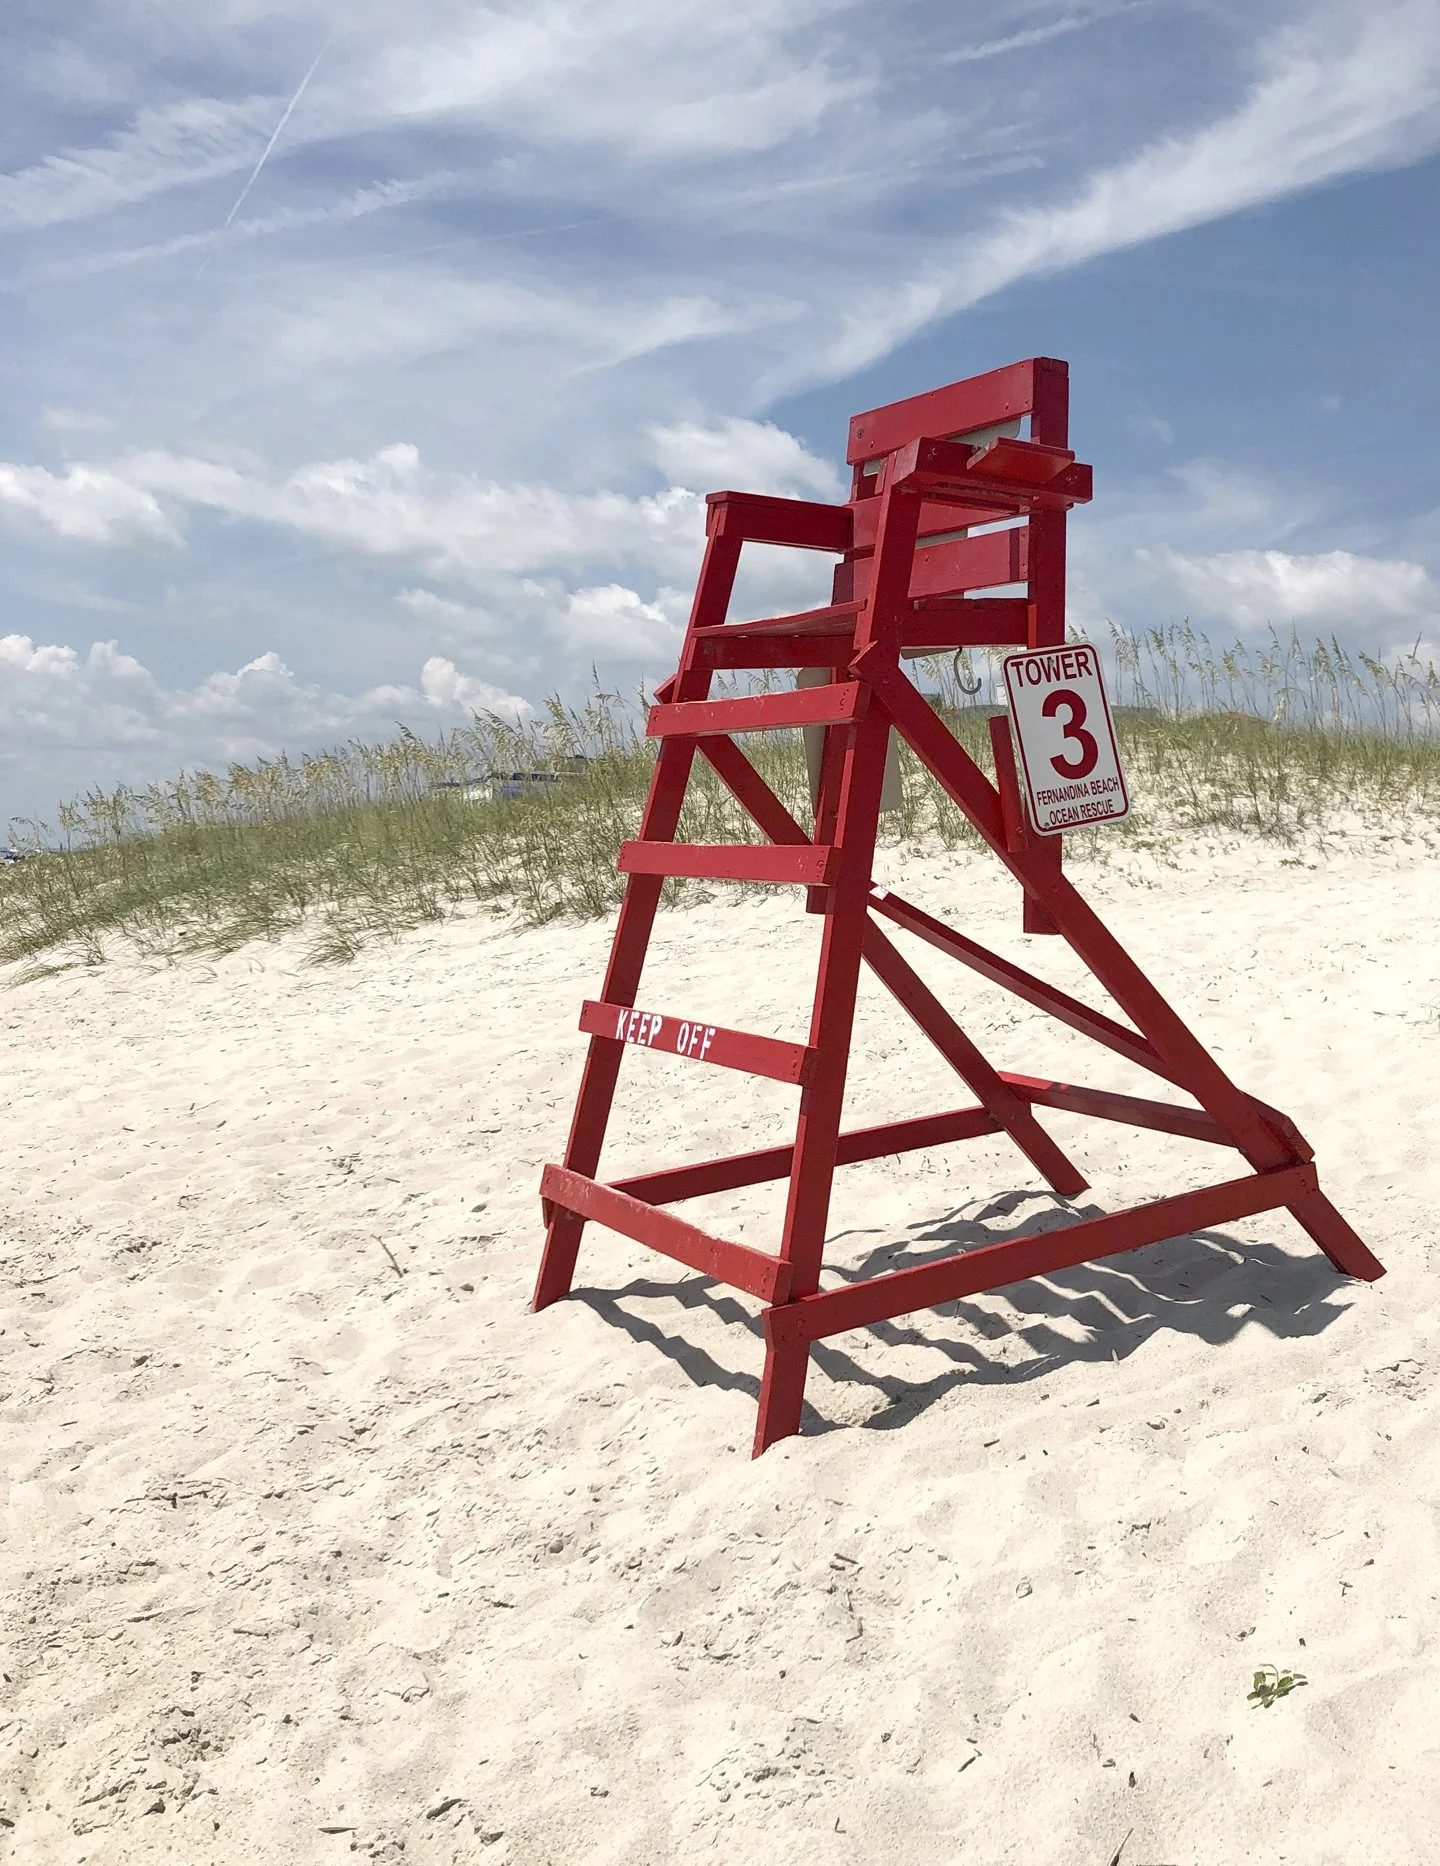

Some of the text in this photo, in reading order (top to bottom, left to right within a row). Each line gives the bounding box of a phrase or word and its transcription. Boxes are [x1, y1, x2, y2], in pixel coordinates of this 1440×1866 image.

[1010, 651, 1093, 688] TOWER
[1041, 688, 1099, 780] 3
[1036, 777, 1120, 807] FERNANDINA BEACH
[1049, 798, 1115, 826] OCEAN RESCUE
[615, 1009, 716, 1060] KEEP OFF
